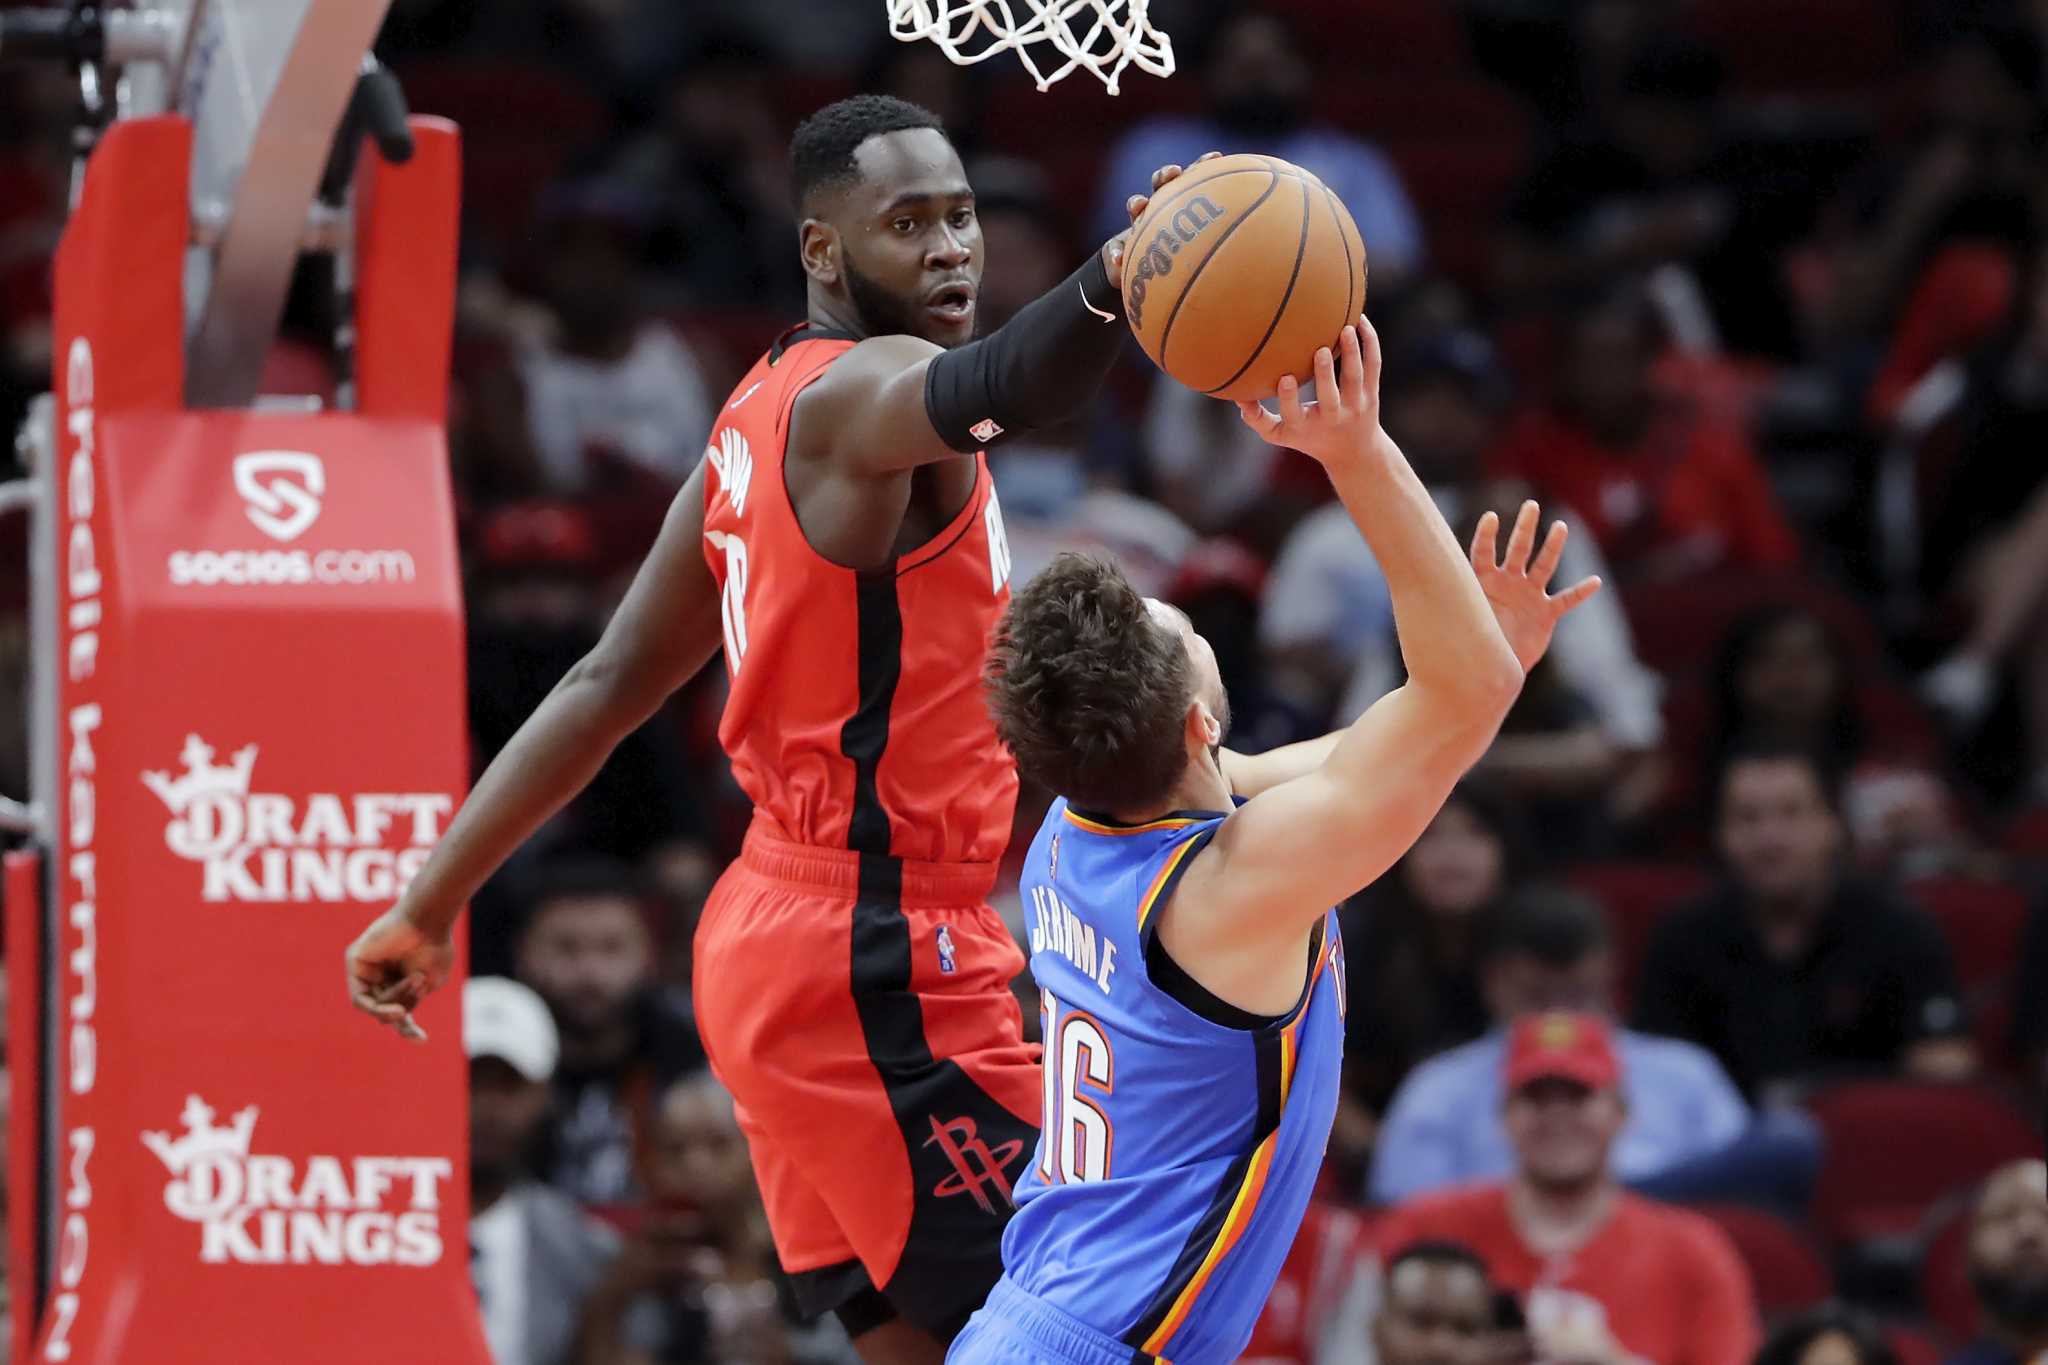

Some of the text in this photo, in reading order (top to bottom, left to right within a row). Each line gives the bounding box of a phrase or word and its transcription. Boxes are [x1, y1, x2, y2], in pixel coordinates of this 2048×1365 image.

[1128, 195, 1226, 330] Wilson
[67, 336, 102, 682] credit
[168, 551, 416, 585] socios.com
[164, 791, 452, 860] DRAFT
[68, 703, 102, 1096] karma
[1032, 886, 1117, 995] JEROME
[1041, 986, 1114, 1185] 16
[163, 1151, 452, 1222] DRAFT
[200, 1207, 443, 1266] KINGS
